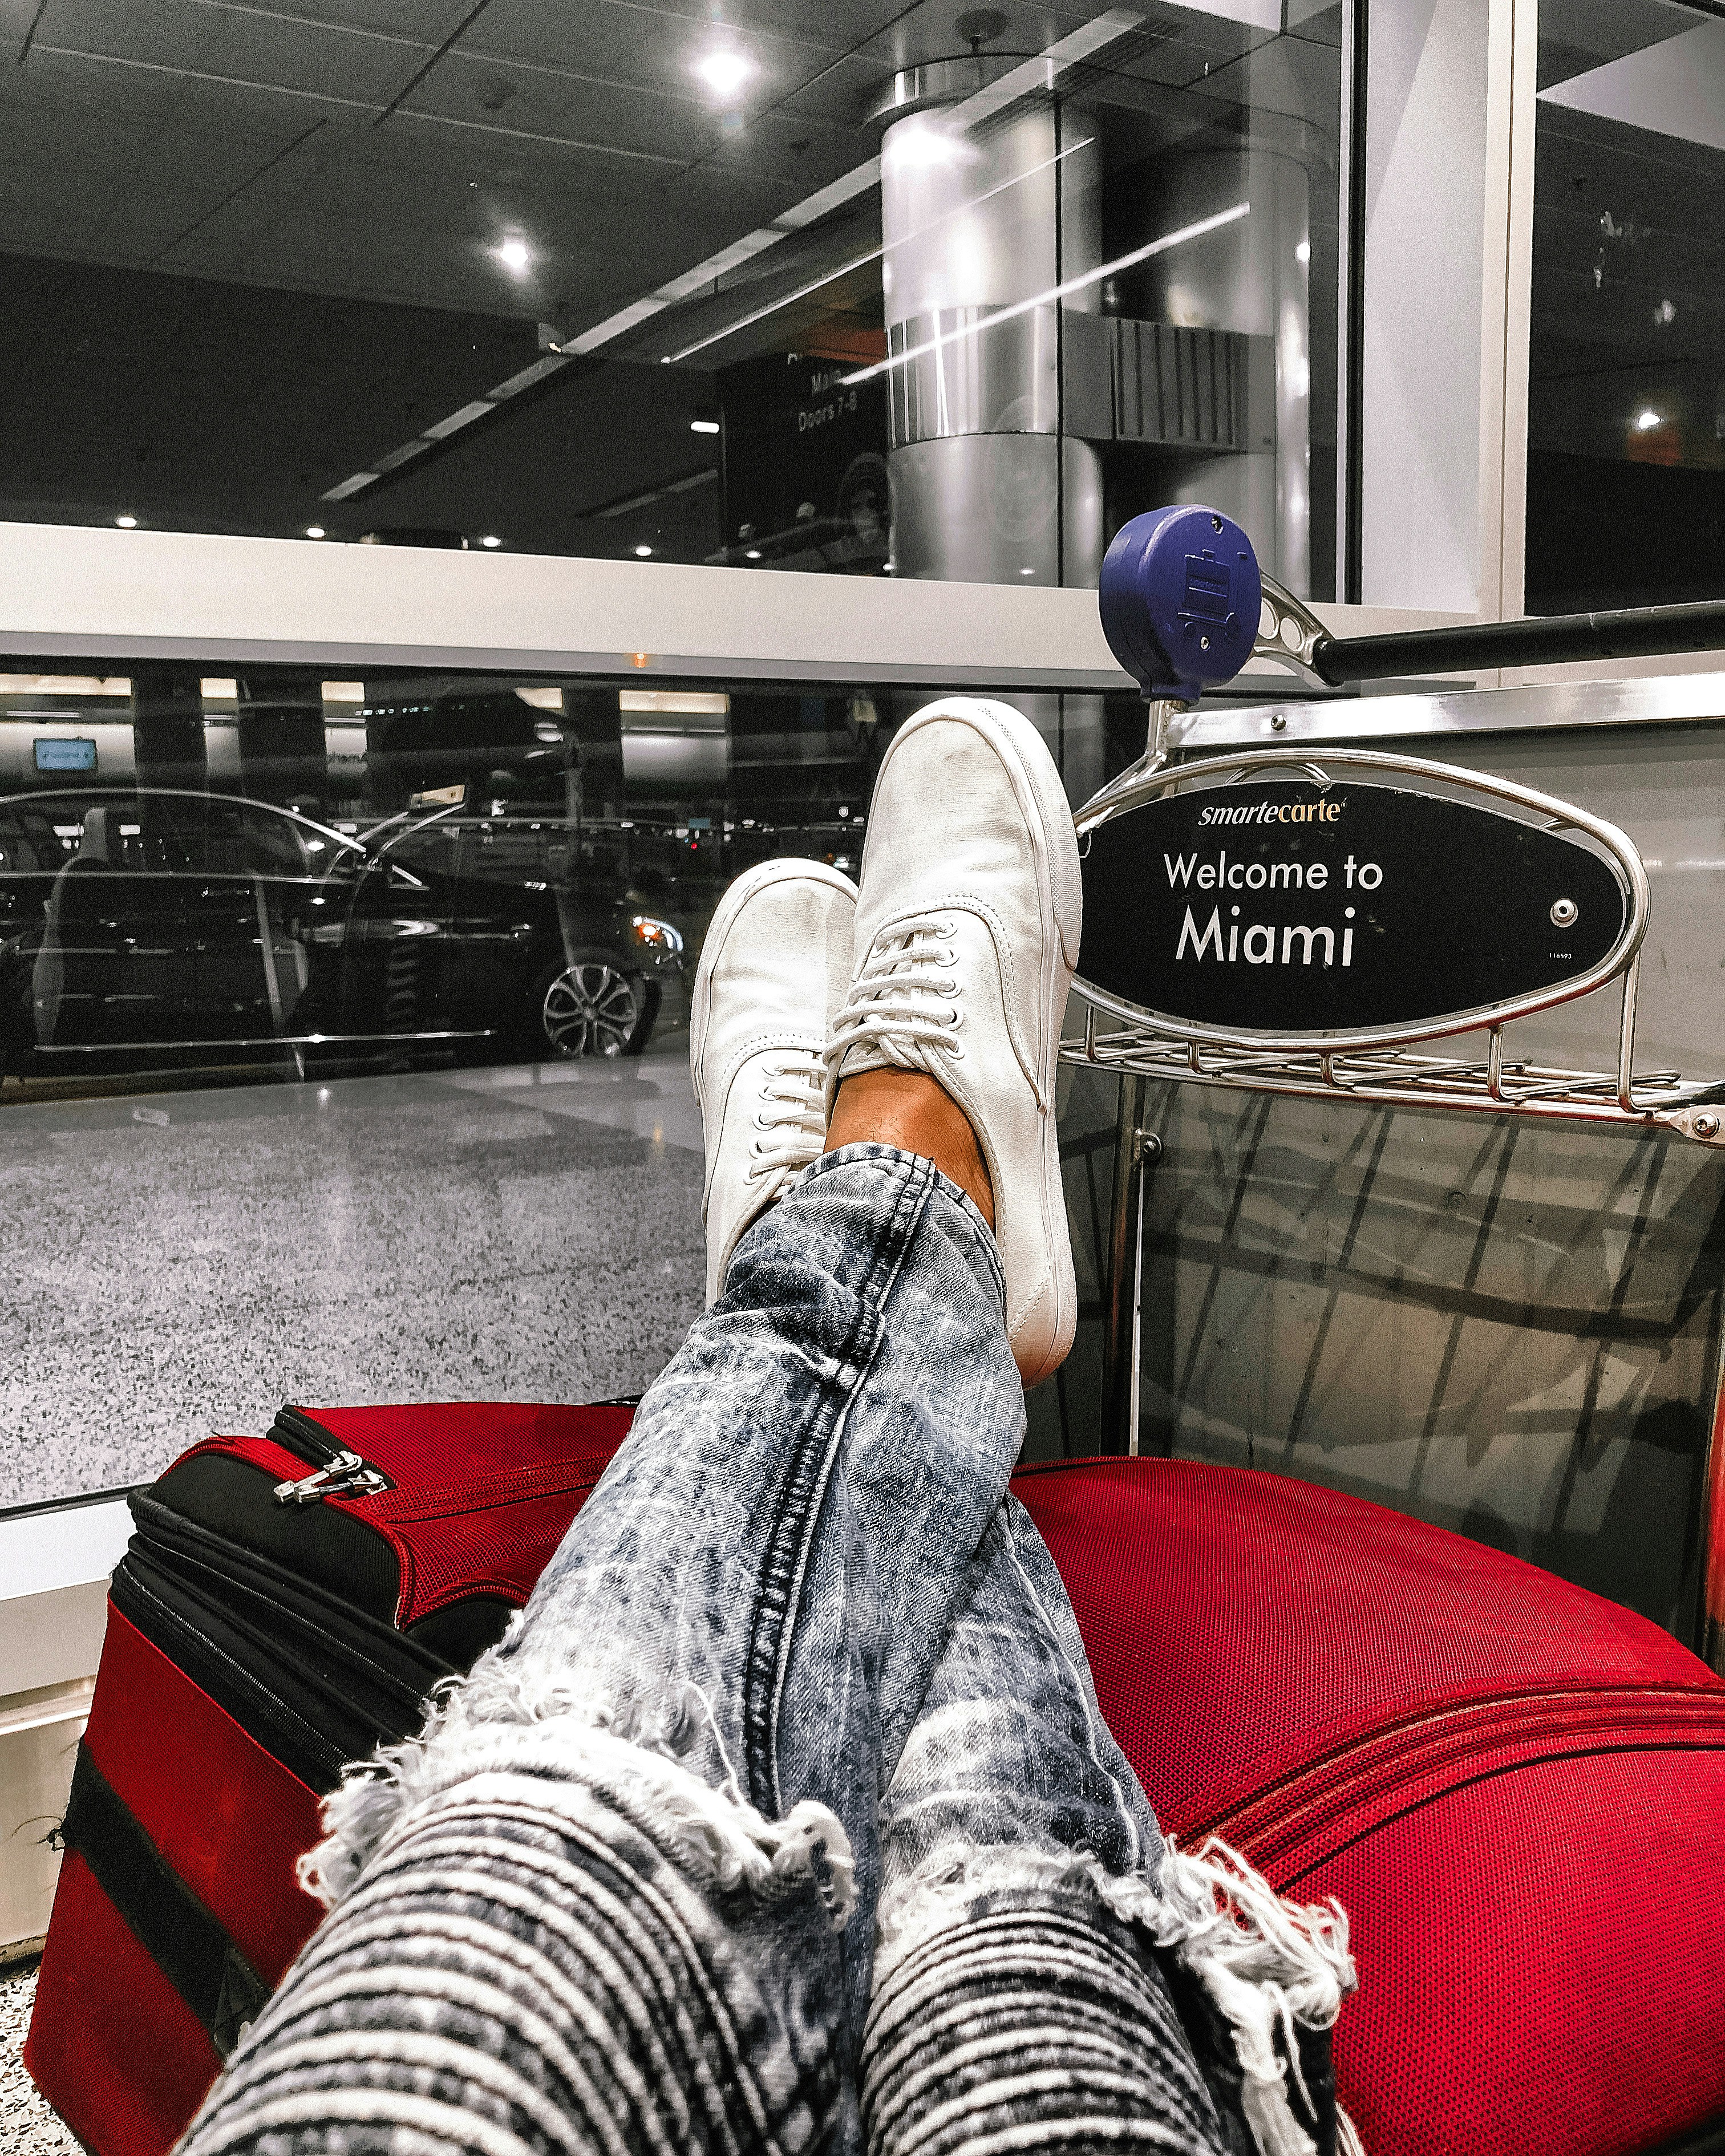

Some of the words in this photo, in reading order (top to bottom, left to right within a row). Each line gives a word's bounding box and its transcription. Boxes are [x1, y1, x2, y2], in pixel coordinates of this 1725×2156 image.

[799, 404, 835, 432] Doors
[1164, 850, 1329, 889] Welcome
[1343, 855, 1383, 890] to
[1176, 905, 1355, 966] Miami
